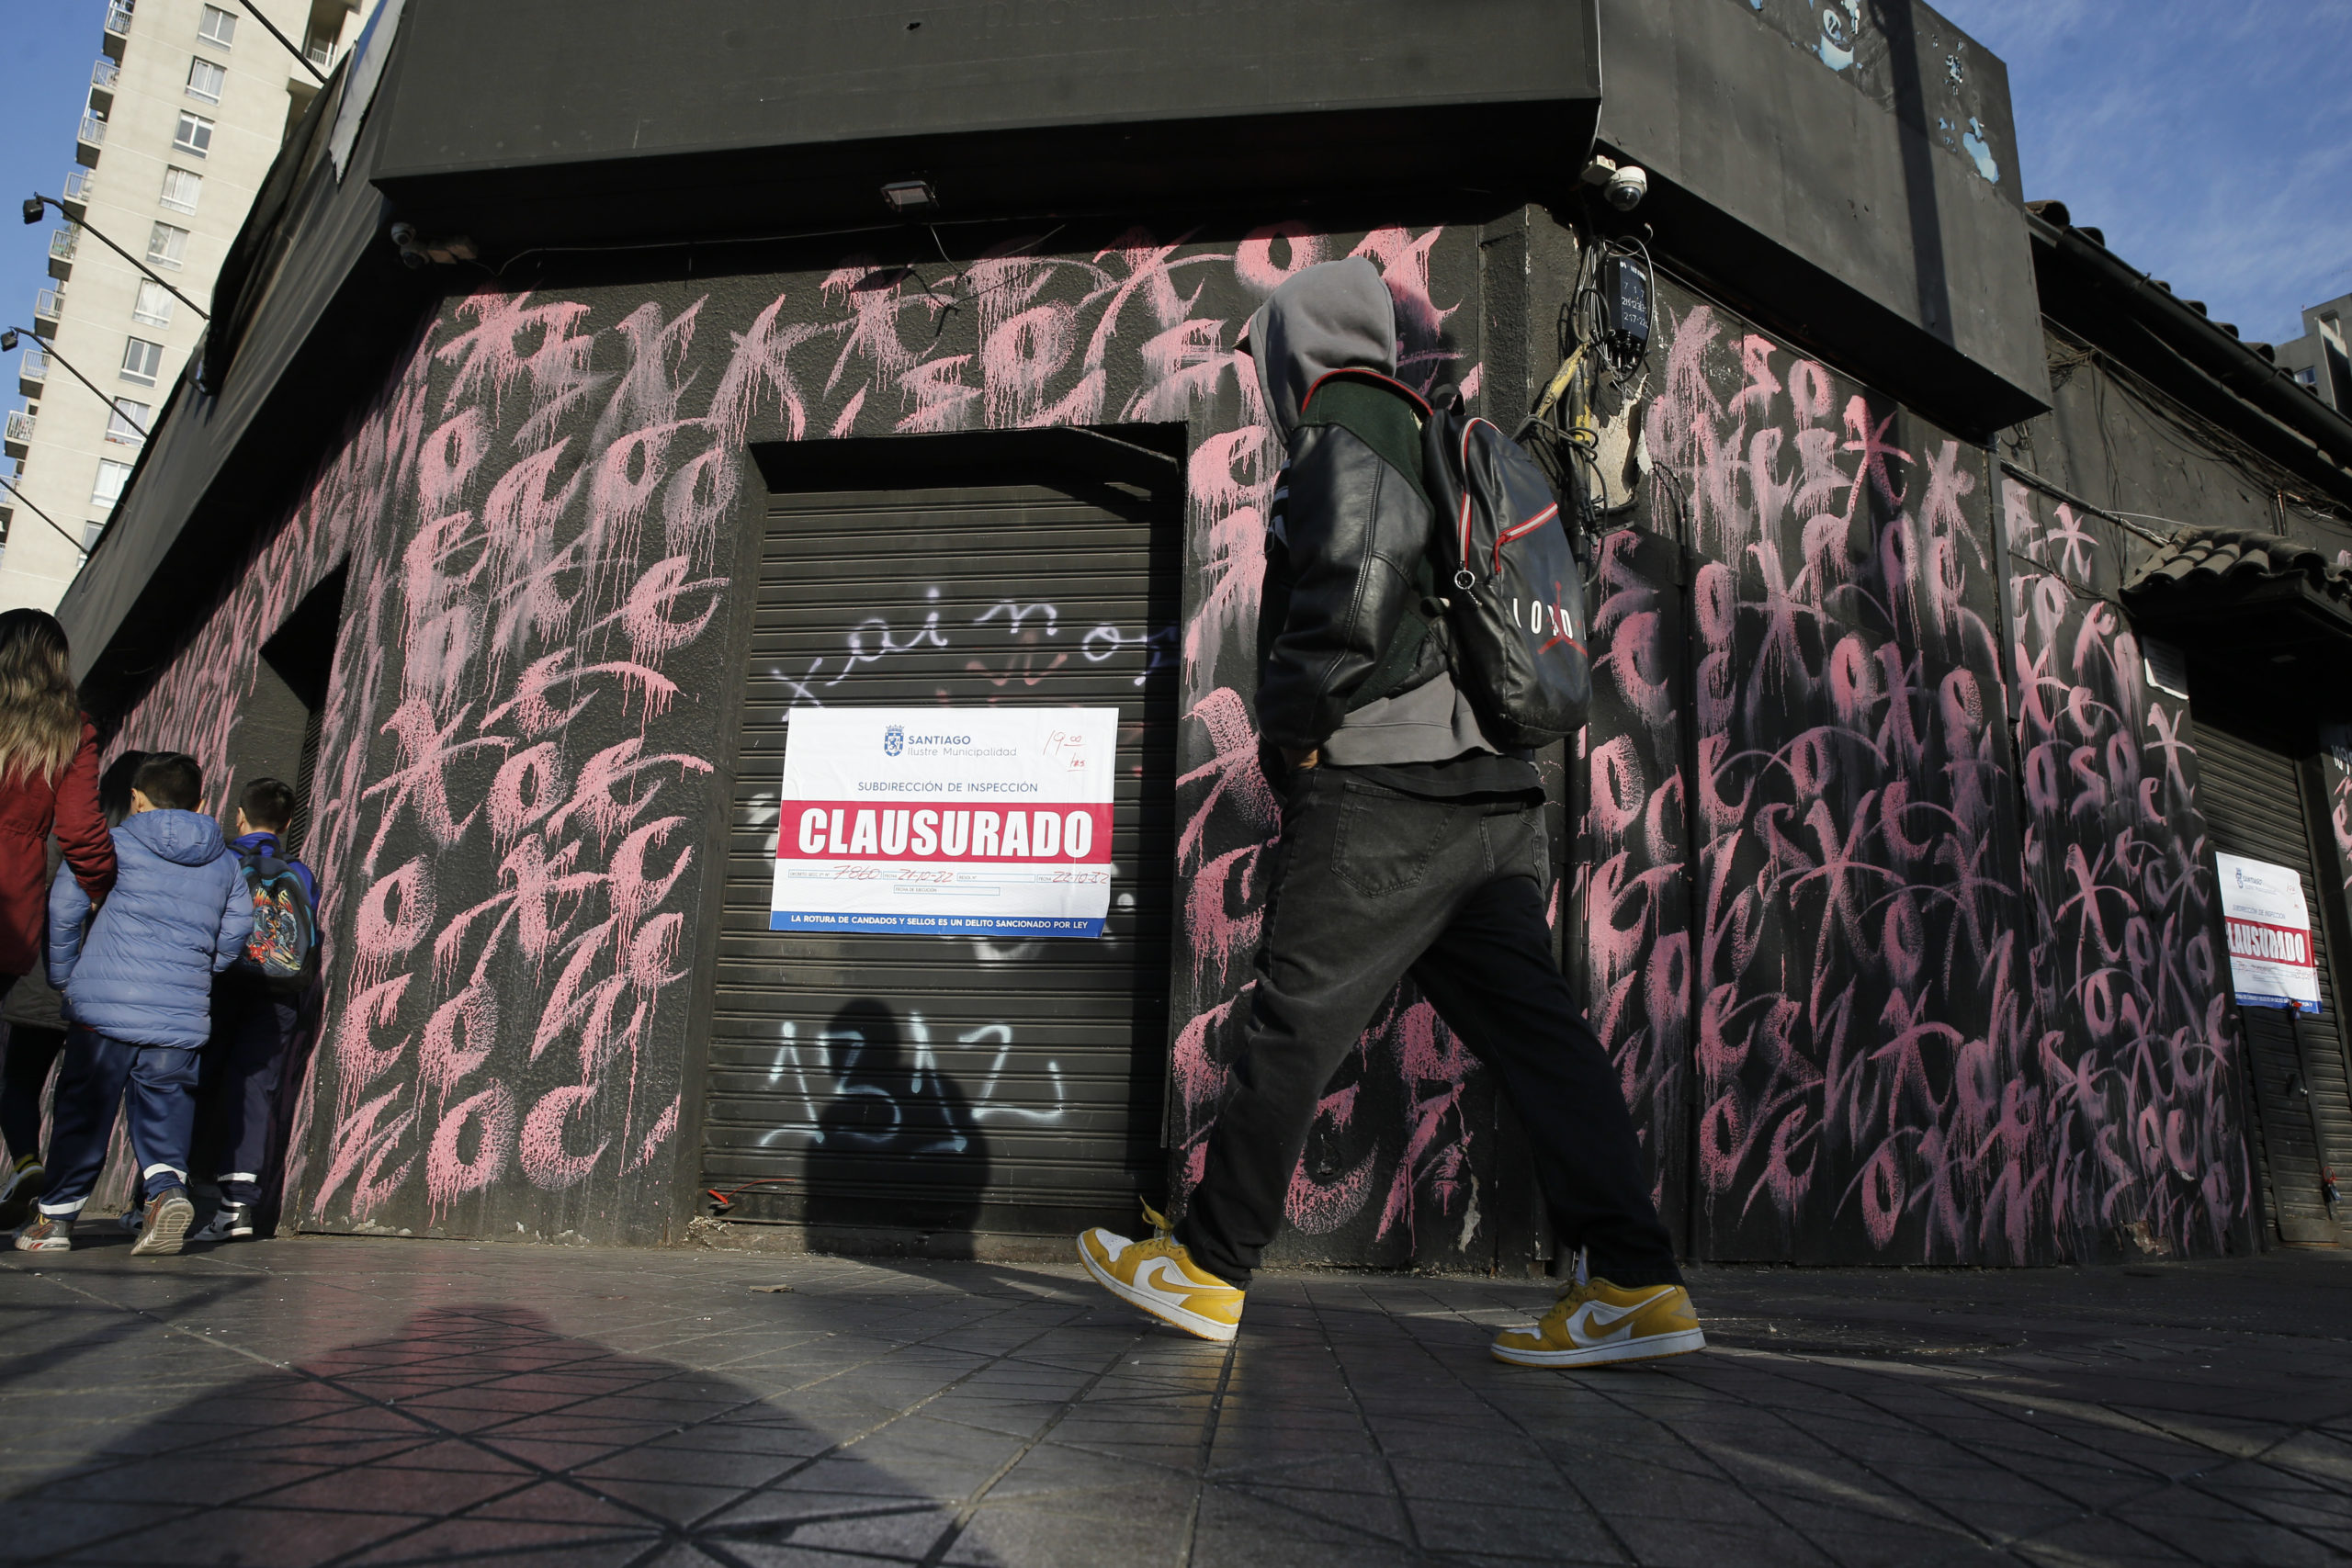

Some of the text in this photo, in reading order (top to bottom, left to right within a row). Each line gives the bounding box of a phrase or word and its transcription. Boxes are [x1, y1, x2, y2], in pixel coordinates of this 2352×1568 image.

[908, 735, 971, 746] SANTIAGO
[908, 747, 1018, 759] Ilustre Municipalidad
[857, 781, 1039, 793] SUBDIRECCIÓN DE INSPECCIÓN
[798, 807, 1093, 859] CLAUSURADO
[791, 915, 802, 923] LA
[803, 915, 836, 924] ROTURA
[838, 916, 849, 924] DE
[851, 916, 898, 925] CANDADOS
[899, 918, 906, 926] Y
[907, 918, 936, 927] SELLOS
[950, 919, 963, 927] UN
[965, 919, 994, 928] DELITO
[995, 919, 1052, 929] SANCIONADO
[1053, 921, 1071, 930] POR
[1073, 921, 1089, 930] LEY
